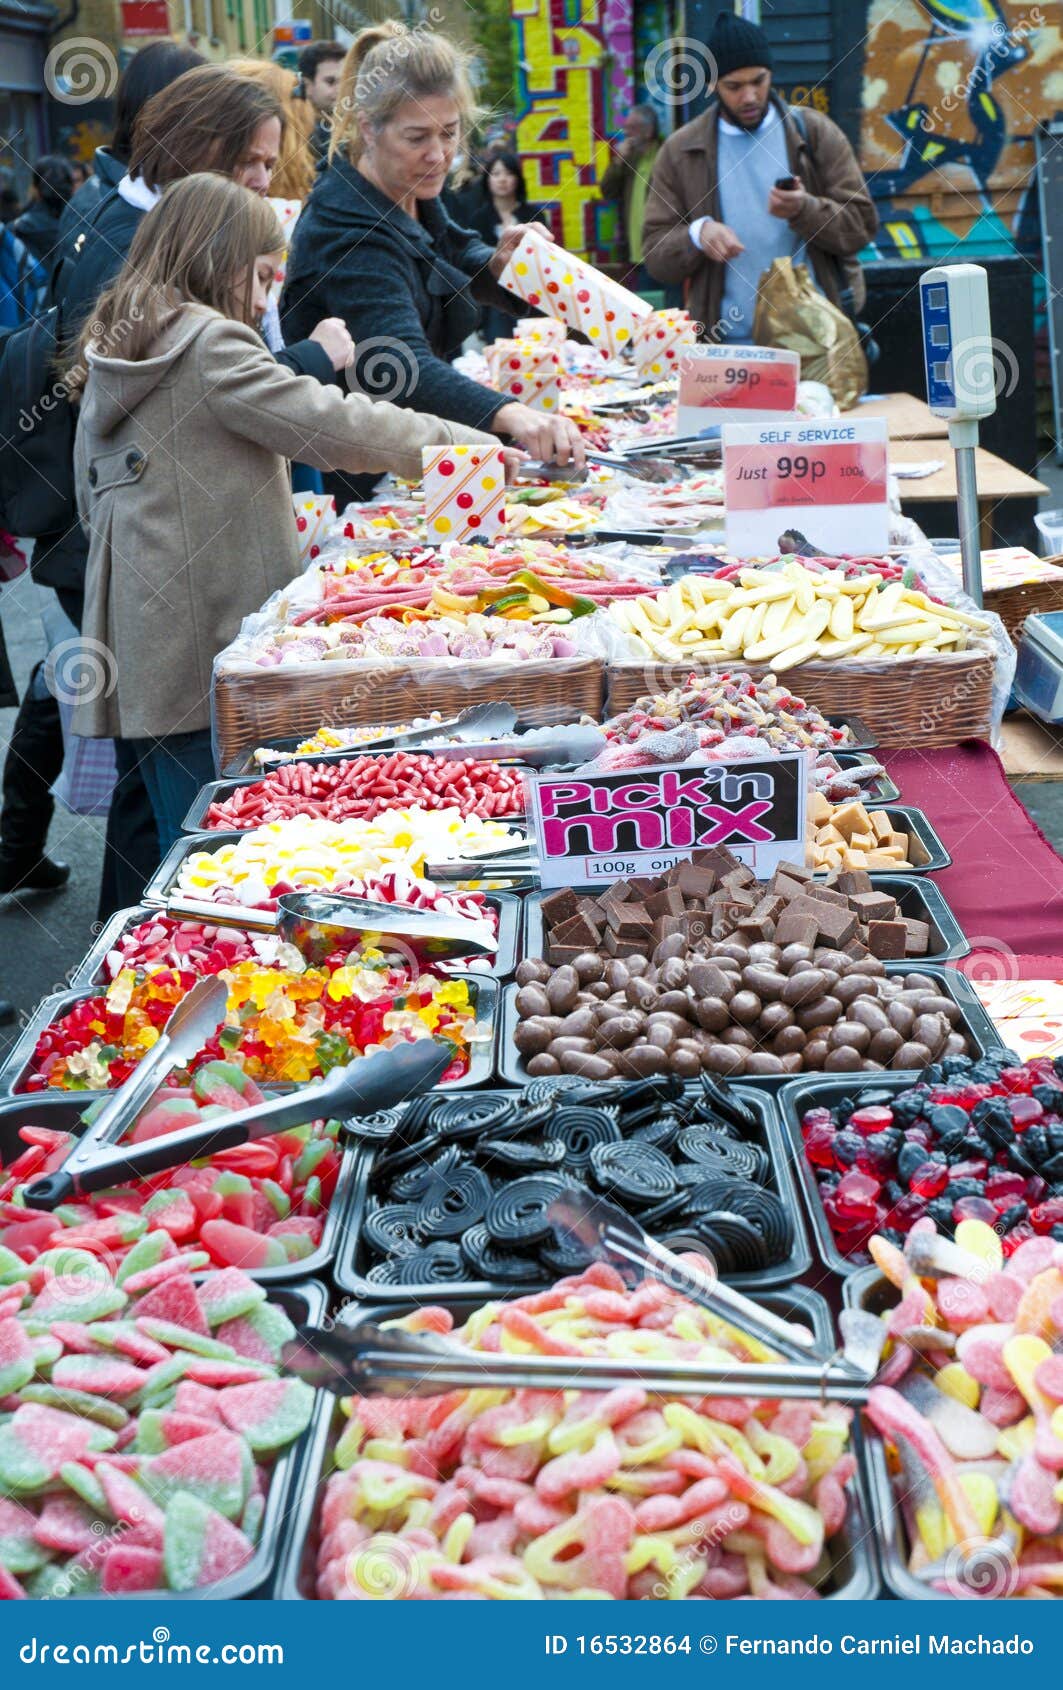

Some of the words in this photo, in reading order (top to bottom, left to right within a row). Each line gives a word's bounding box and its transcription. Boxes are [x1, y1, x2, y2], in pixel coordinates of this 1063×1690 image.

[724, 367, 761, 389] 99p
[760, 431, 791, 443] SELF
[797, 427, 856, 442] SERVICE
[736, 466, 768, 480] Just
[776, 456, 826, 482] 99p
[538, 766, 775, 817] Pick'n
[592, 861, 636, 874] 100g
[651, 857, 681, 870] onl
